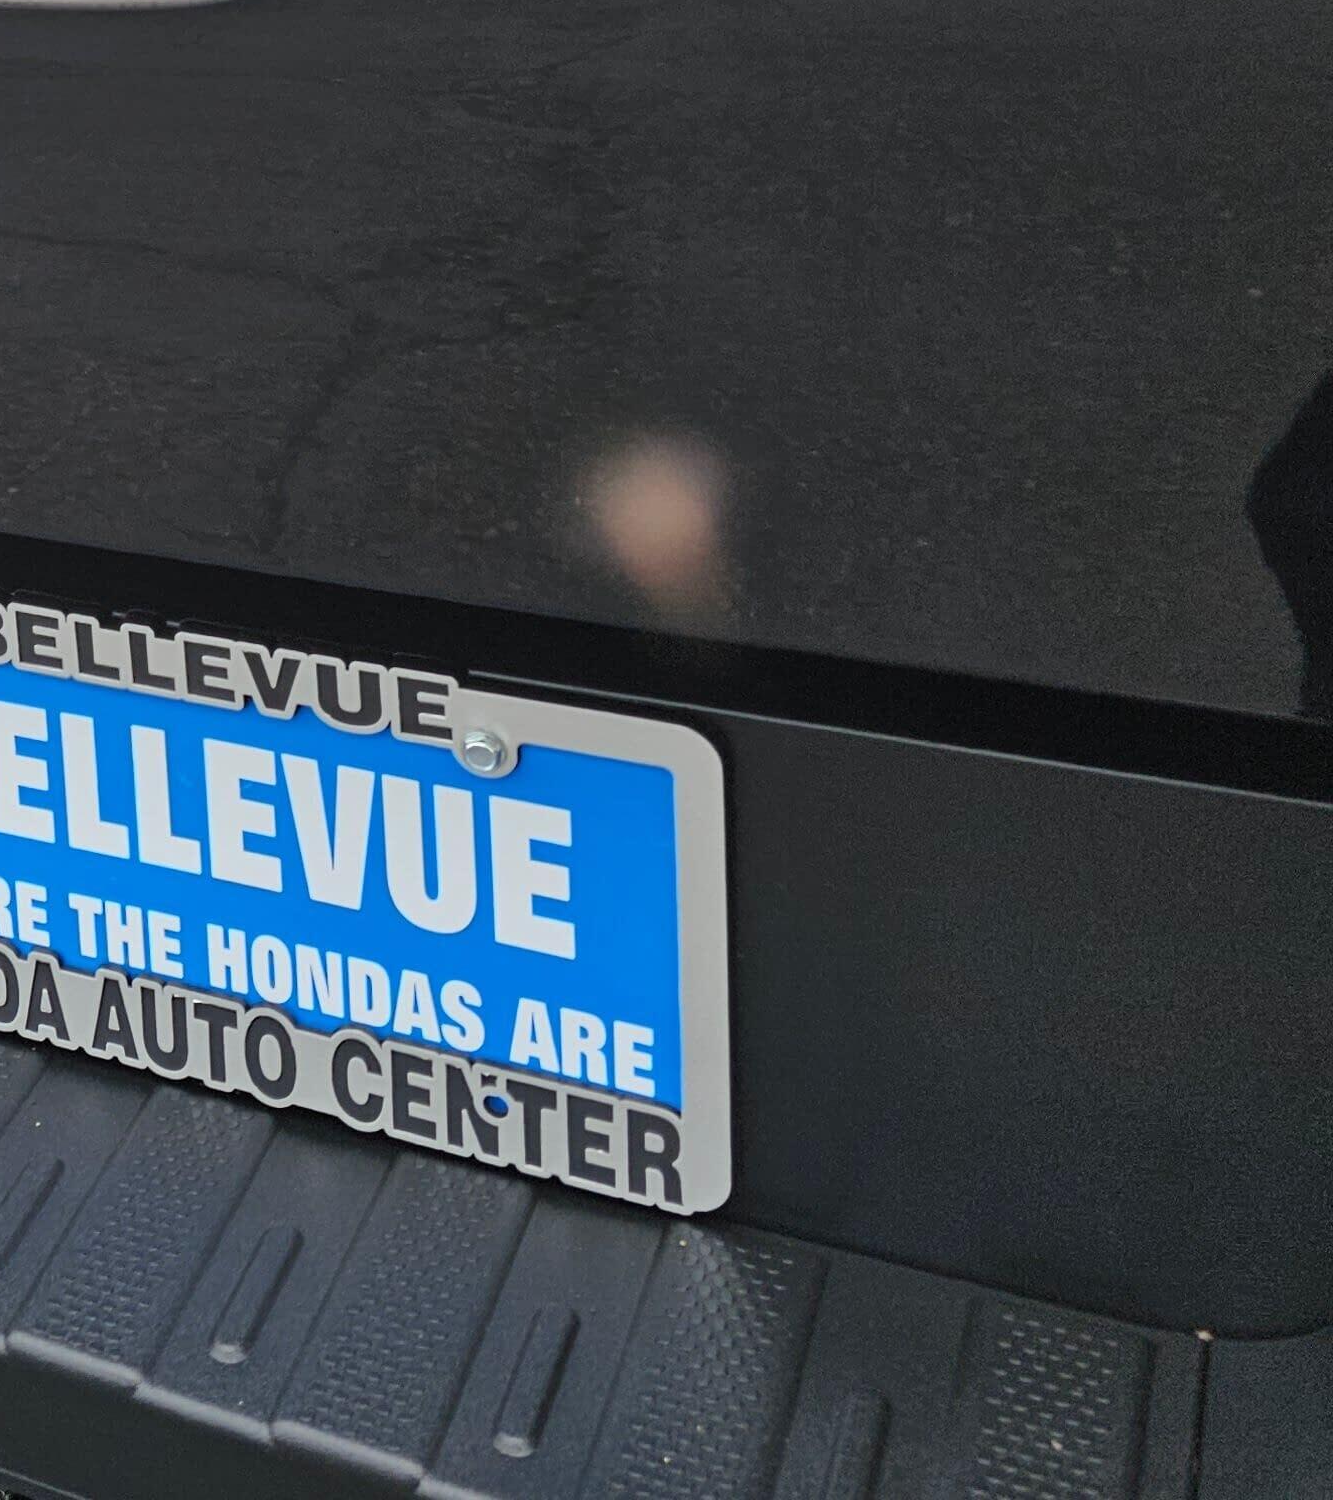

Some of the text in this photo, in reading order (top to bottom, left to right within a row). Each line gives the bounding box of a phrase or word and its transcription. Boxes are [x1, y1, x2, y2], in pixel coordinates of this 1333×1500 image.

[68, 891, 184, 979] THE
[207, 927, 484, 1052] HONDAS
[509, 998, 657, 1097] ARE
[92, 976, 299, 1100] AUTO
[330, 1037, 685, 1207] CENTER
